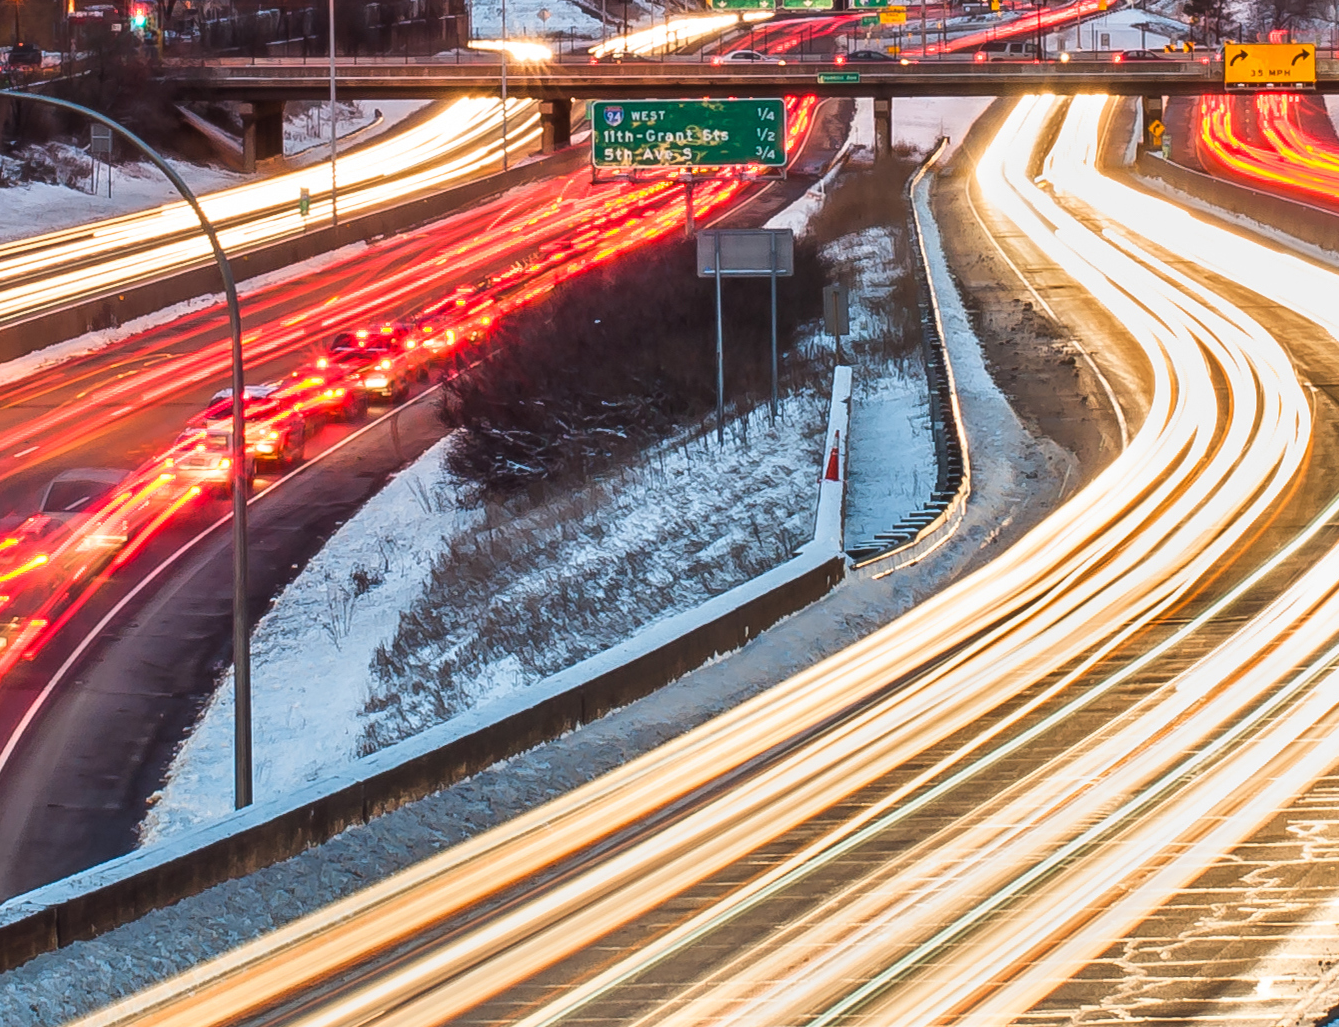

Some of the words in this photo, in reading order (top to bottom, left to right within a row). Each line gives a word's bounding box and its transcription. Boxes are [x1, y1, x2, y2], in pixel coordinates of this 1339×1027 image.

[1250, 69, 1263, 77] 35
[1268, 69, 1291, 77] MPH
[606, 111, 622, 122] 94
[630, 110, 666, 121] WEST
[757, 107, 775, 121] 1/4
[603, 129, 693, 143] 11th-Grant
[702, 129, 729, 141] Sts
[756, 127, 776, 142] 1/2
[604, 148, 632, 161] 5th
[642, 147, 674, 161] Ave
[682, 147, 693, 160] S
[755, 146, 776, 160] 3/4
